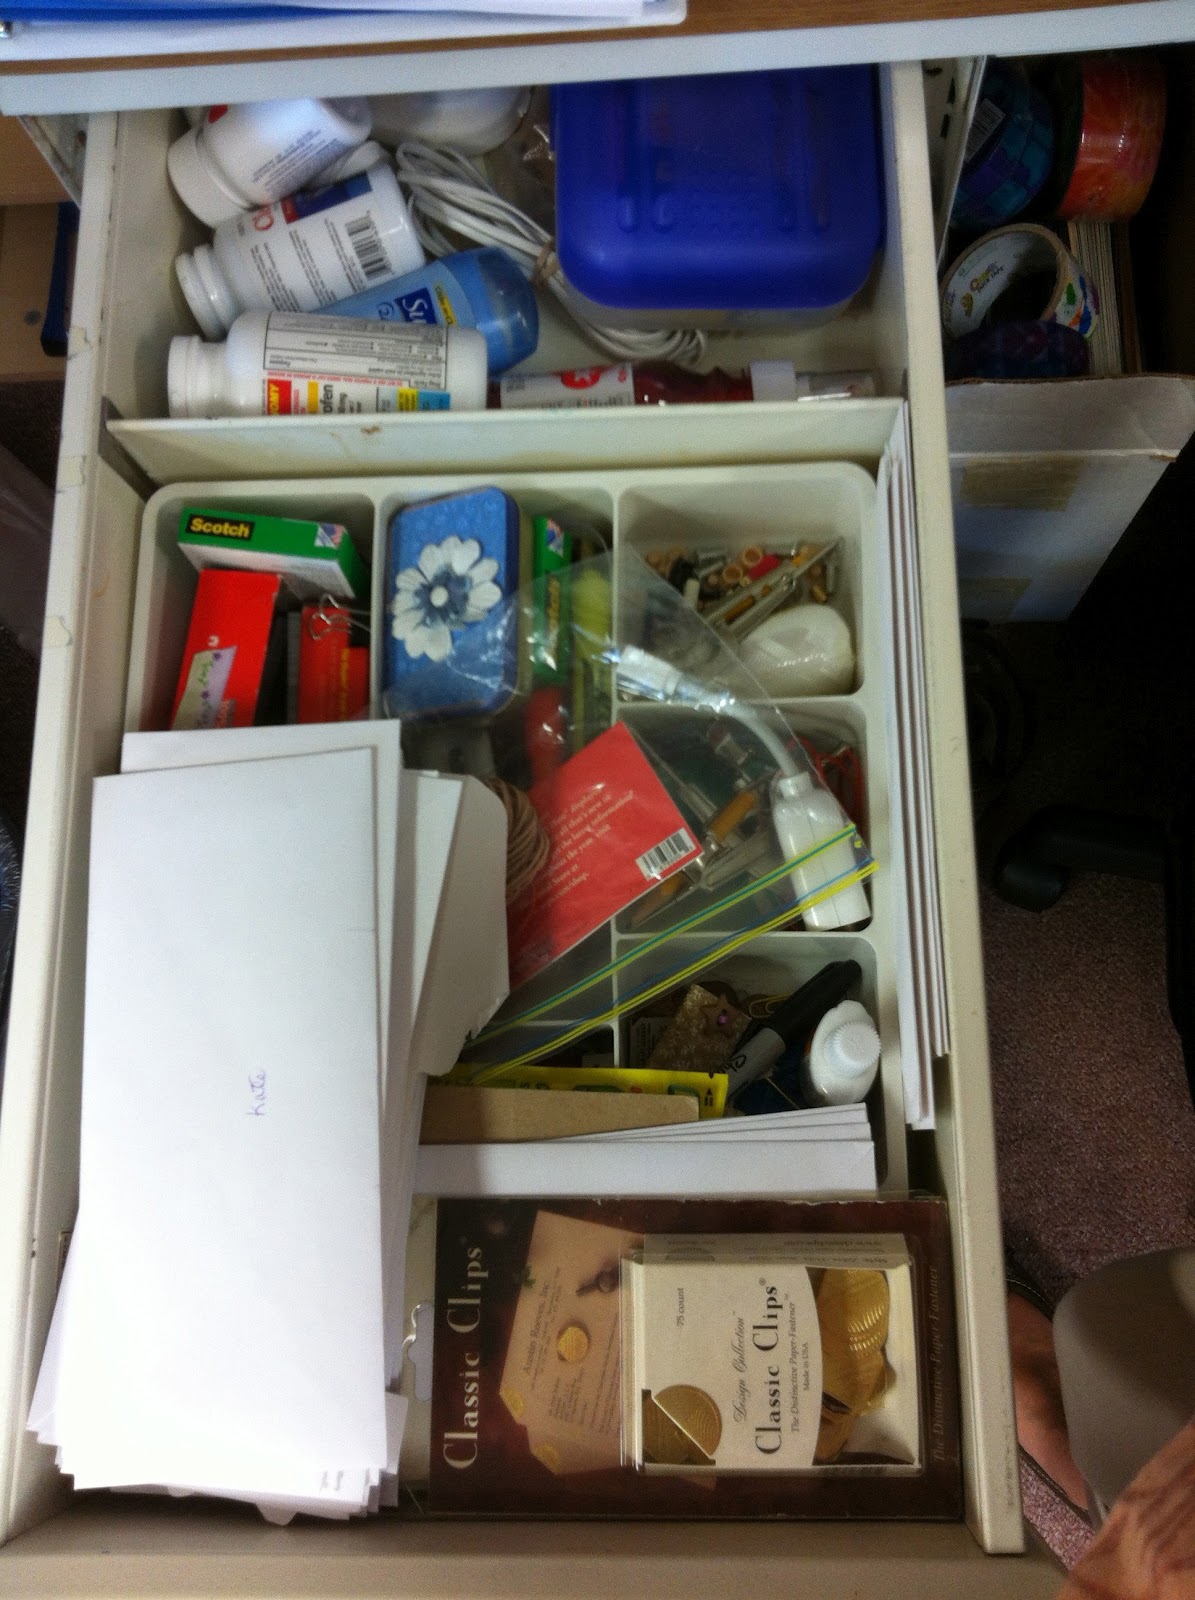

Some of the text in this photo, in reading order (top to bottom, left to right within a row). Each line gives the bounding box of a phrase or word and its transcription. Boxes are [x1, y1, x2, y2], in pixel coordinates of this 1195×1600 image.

[189, 517, 250, 538] Scotch
[245, 1068, 266, 1117] Kate
[675, 1287, 685, 1327] 75 count
[442, 1246, 489, 1470] Classic Clips
[732, 1379, 750, 1423] Design
[789, 1366, 799, 1415] Distinctive
[802, 1370, 810, 1391] Made
[754, 1366, 782, 1455] Classic
[792, 1416, 800, 1433] The
